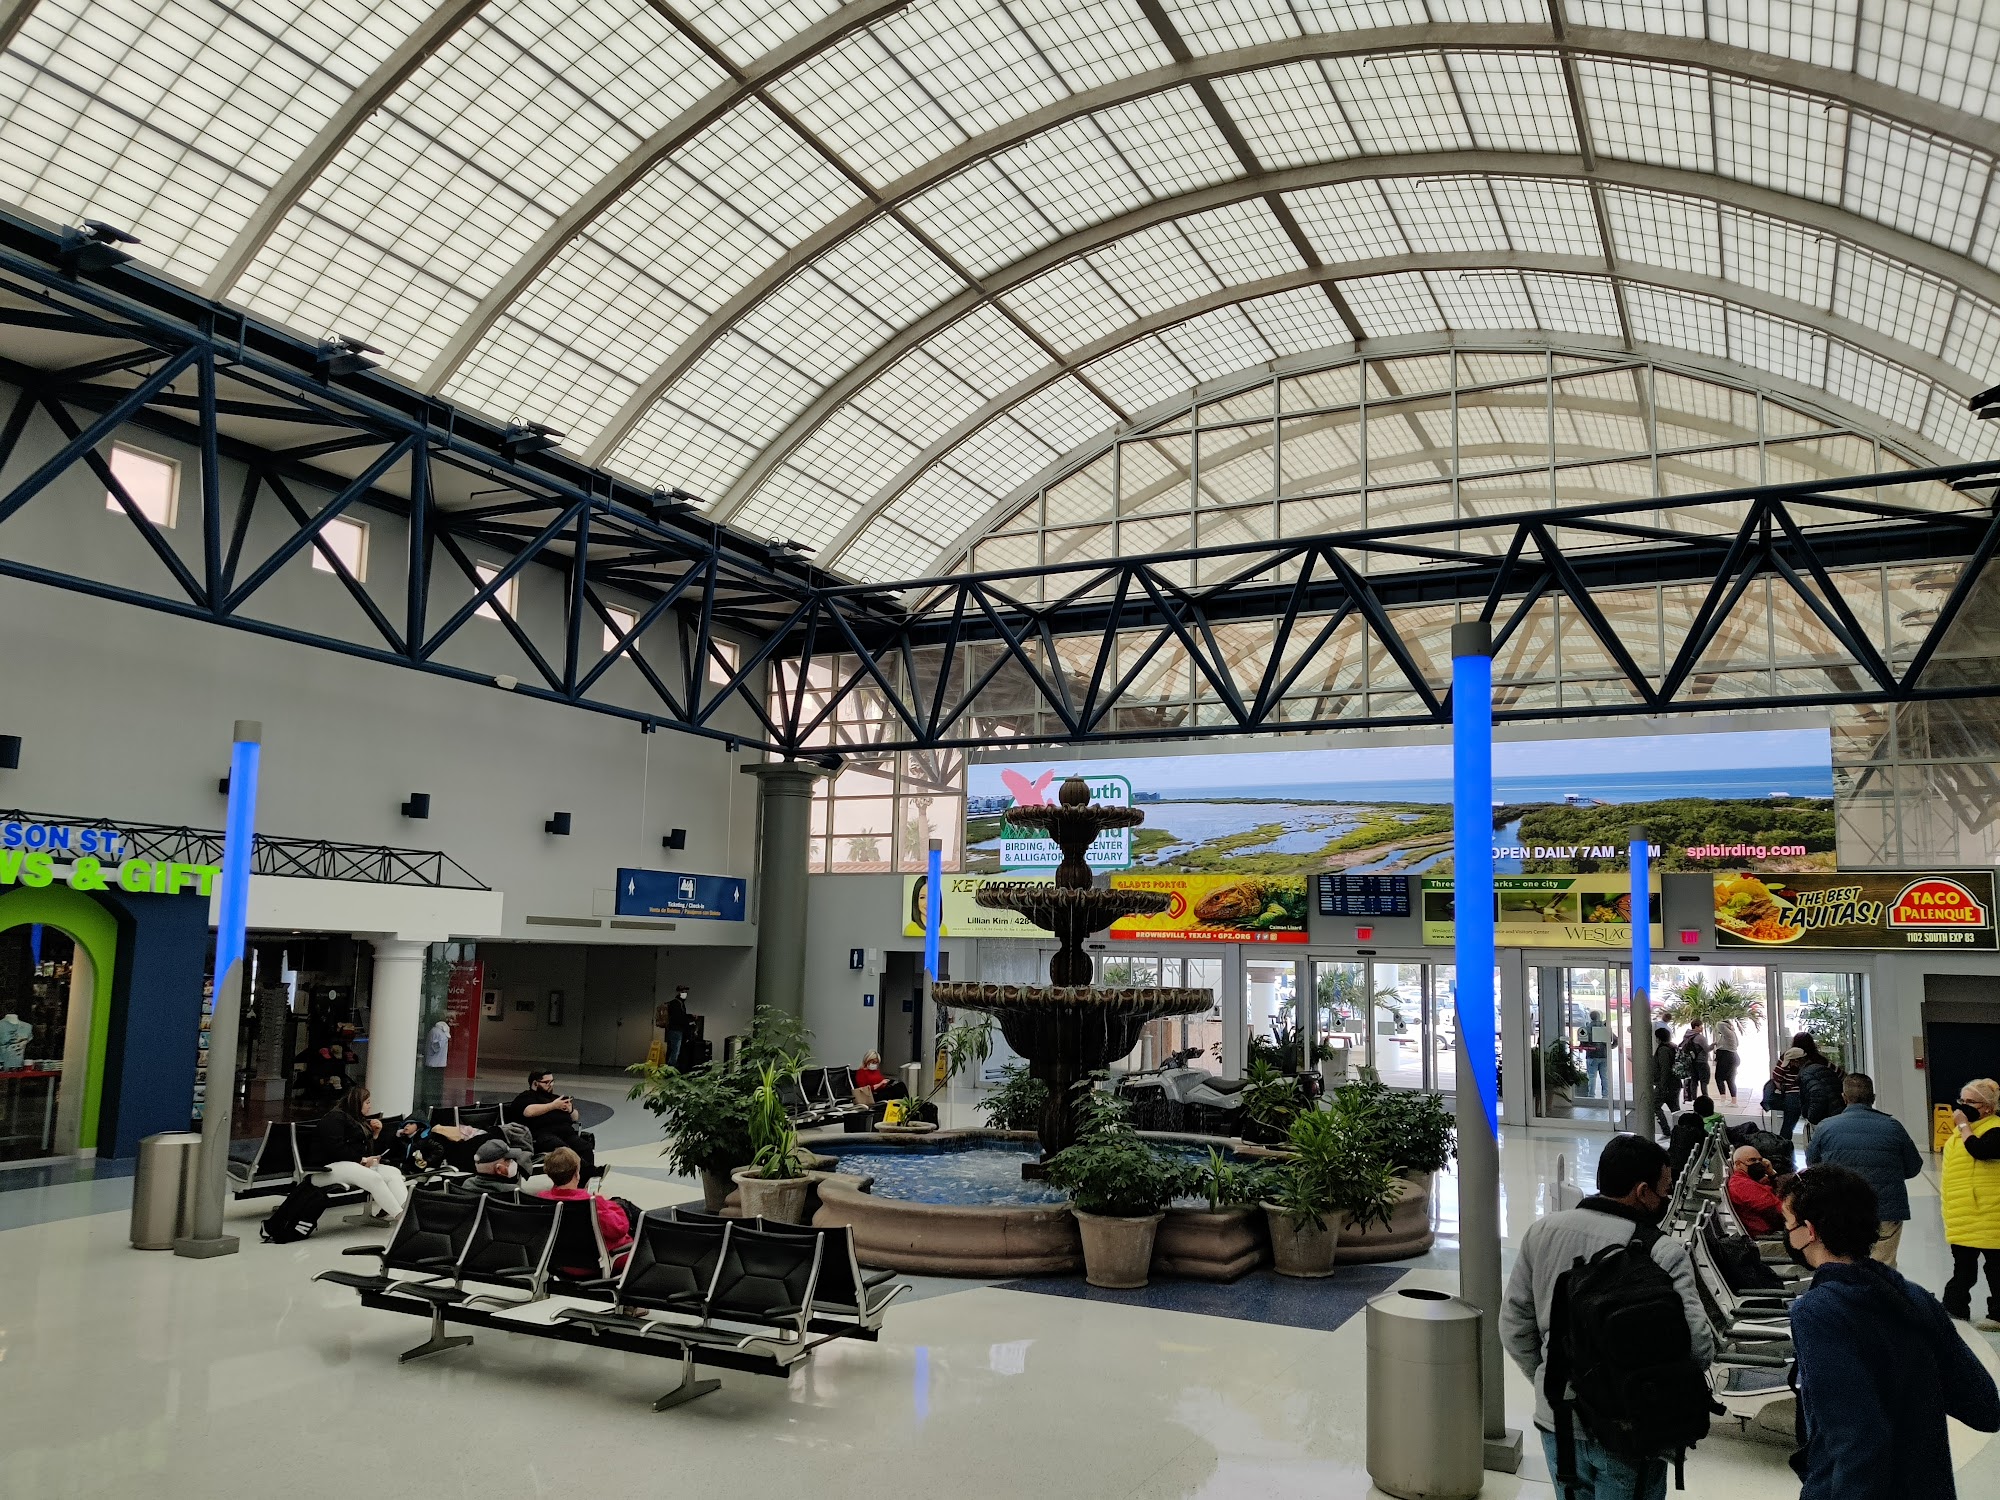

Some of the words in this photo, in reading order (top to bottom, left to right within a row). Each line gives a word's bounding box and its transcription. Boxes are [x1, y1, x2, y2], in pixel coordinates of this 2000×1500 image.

[1090, 783, 1121, 799] uth
[0, 823, 69, 849] SON
[80, 829, 124, 855] ST.
[1005, 842, 1046, 852] BIRDING,
[1492, 847, 1531, 859] OPEN
[1534, 846, 1580, 859] DAILY
[1582, 845, 1615, 858] 7AM
[1687, 843, 1806, 861] spibirding.com
[1014, 852, 1064, 862] ALLIGATOR
[1086, 852, 1123, 861] CTUARY
[71, 857, 110, 891] &
[119, 858, 221, 897] GIFT
[1117, 880, 1152, 889] GLADYS
[1153, 880, 1188, 889] PORTER
[1431, 880, 1455, 888] Three
[1494, 880, 1513, 888] arks
[1541, 880, 1559, 889] city
[1797, 892, 1826, 907] THE
[1828, 886, 1863, 903] BEST
[1911, 891, 1960, 905] TACO
[967, 917, 991, 925] Lillian
[1778, 900, 1884, 928] FAJITAS!
[1900, 906, 1976, 922] PALENQUE
[1135, 931, 1187, 940] BROWNSVILLE,
[1188, 932, 1212, 940] TEXAS
[1218, 932, 1251, 940] GPZ.ORG
[1564, 926, 1633, 942] WESLAC
[1907, 933, 1923, 942] 1102
[1924, 933, 1948, 942] SOUTH
[1949, 933, 1963, 942] EXP
